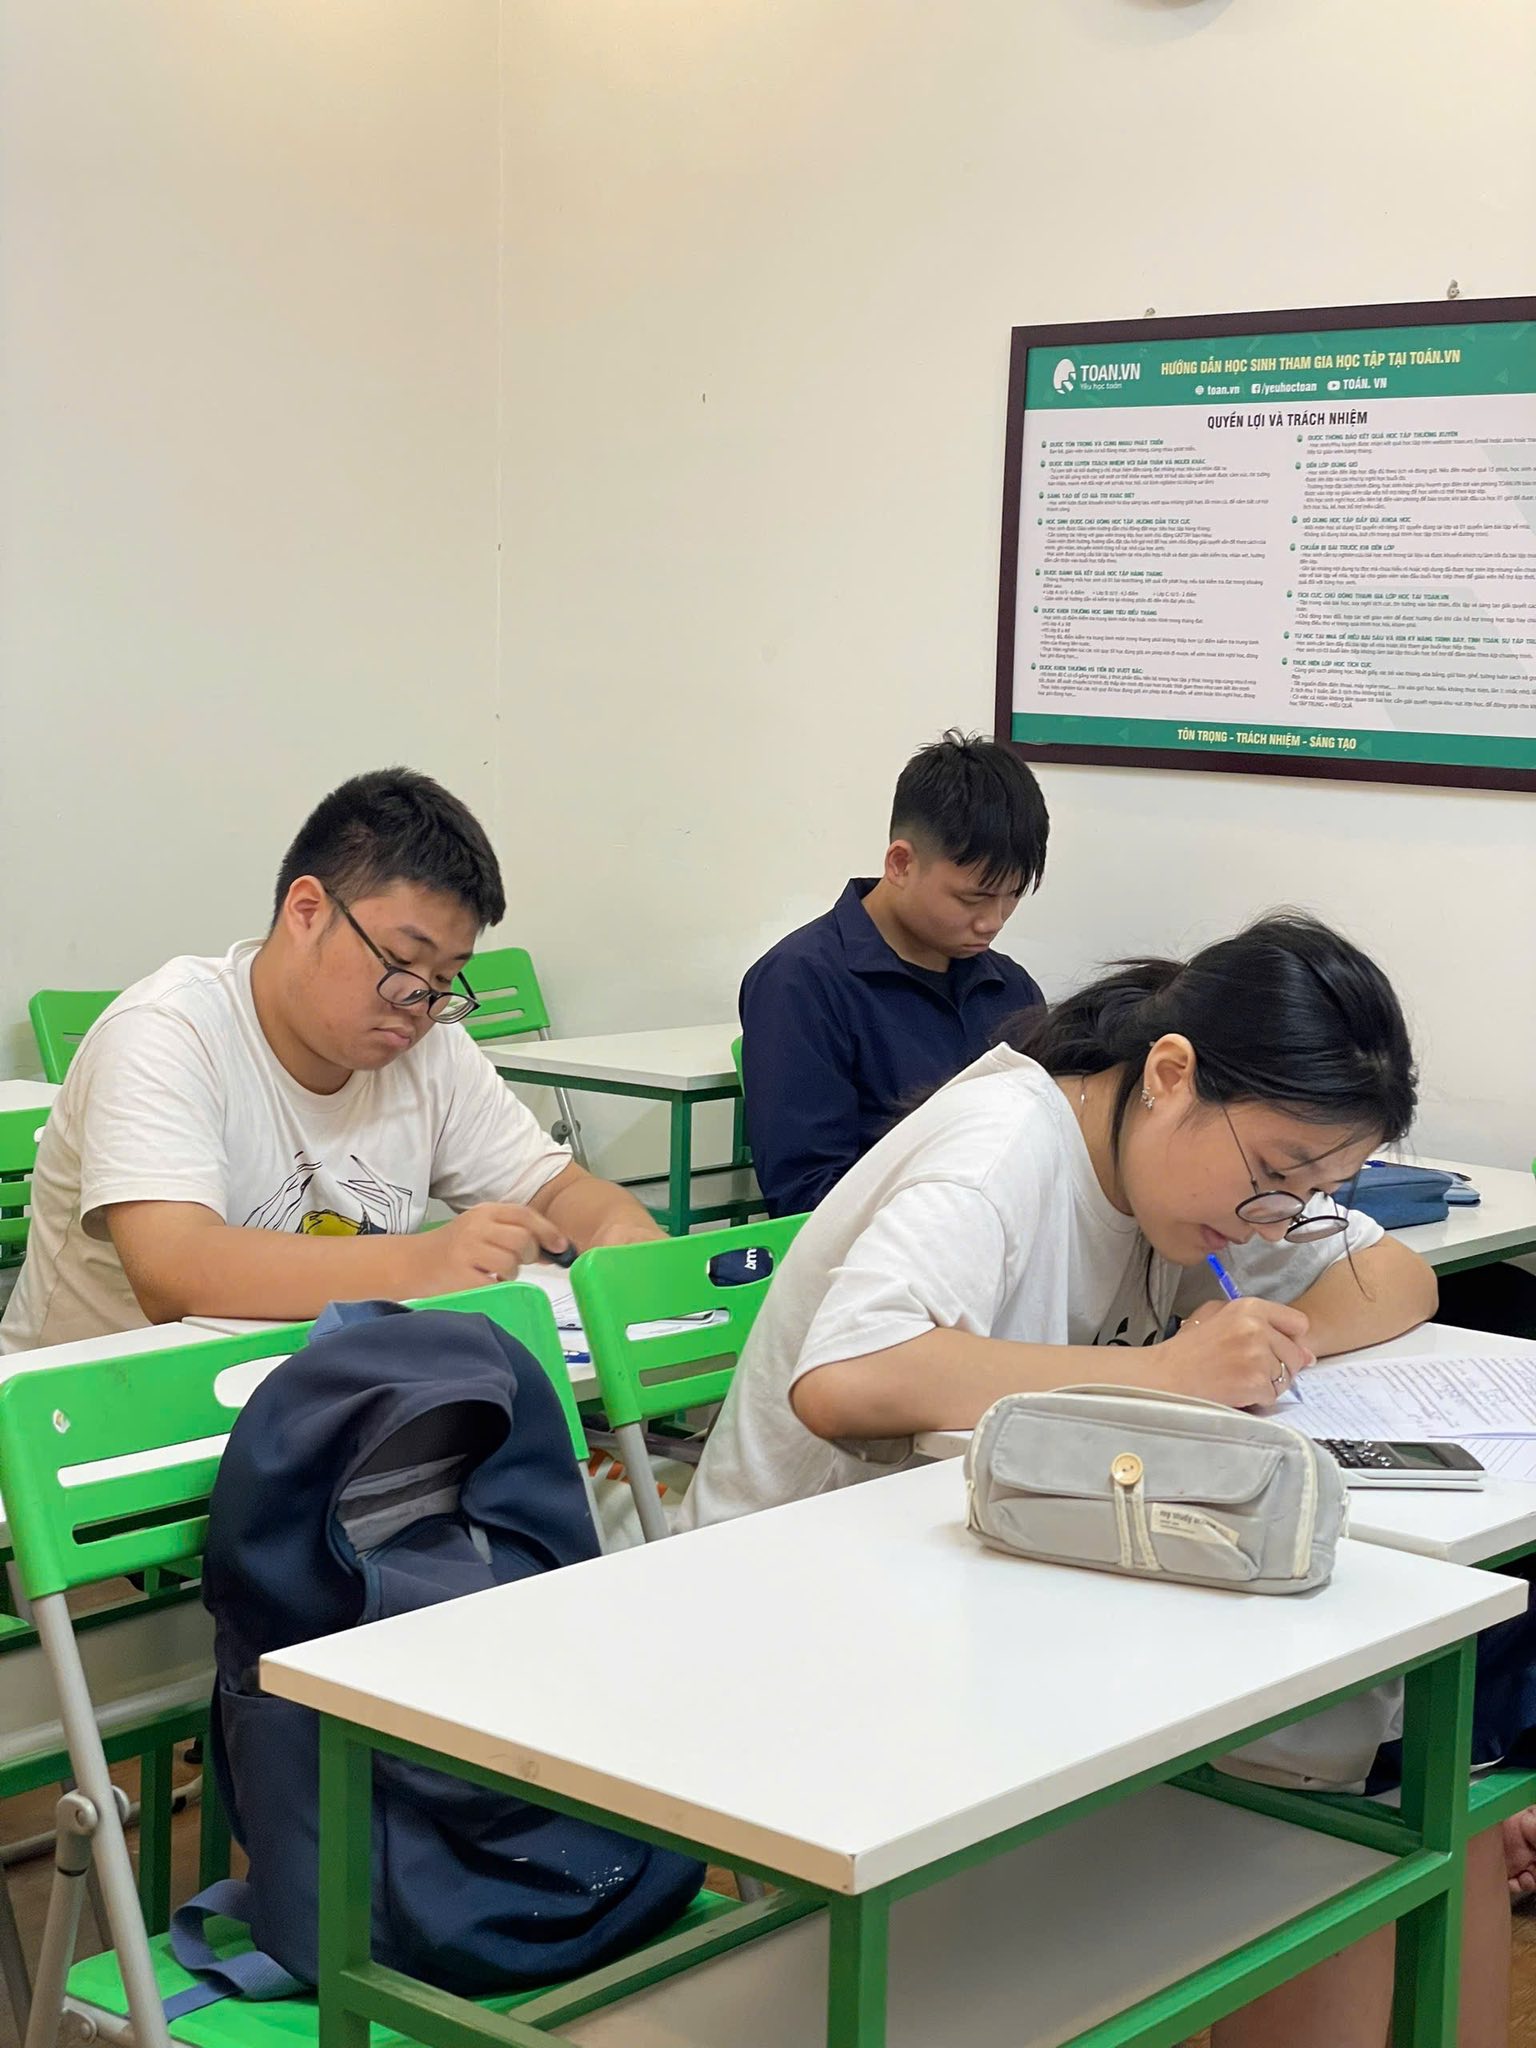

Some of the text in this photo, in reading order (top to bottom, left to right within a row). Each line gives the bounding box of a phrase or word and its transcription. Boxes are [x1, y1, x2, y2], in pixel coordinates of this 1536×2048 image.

[1224, 359, 1248, 375] HỌC
[1250, 358, 1276, 372] SINH
[1279, 356, 1311, 370] THAM
[1314, 355, 1333, 369] GIA
[1336, 354, 1360, 370] HỌC
[1363, 350, 1386, 369] TẬP
[1388, 352, 1407, 368] TẠI
[1410, 348, 1461, 365] TOÁN.VN
[1080, 362, 1140, 382] TOAN.VN
[1207, 386, 1240, 395] toan.vn
[1374, 378, 1387, 388] VN
[1287, 410, 1324, 427] TRÁCH
[1329, 409, 1368, 427] NHIỆM
[1178, 727, 1195, 740] TÔN
[1198, 731, 1227, 743] TRỌNG
[1236, 730, 1266, 744] TRÁCH
[1270, 732, 1300, 748] NHIỆM
[1309, 734, 1335, 748] SÁNG
[1338, 738, 1356, 751] TẠO
